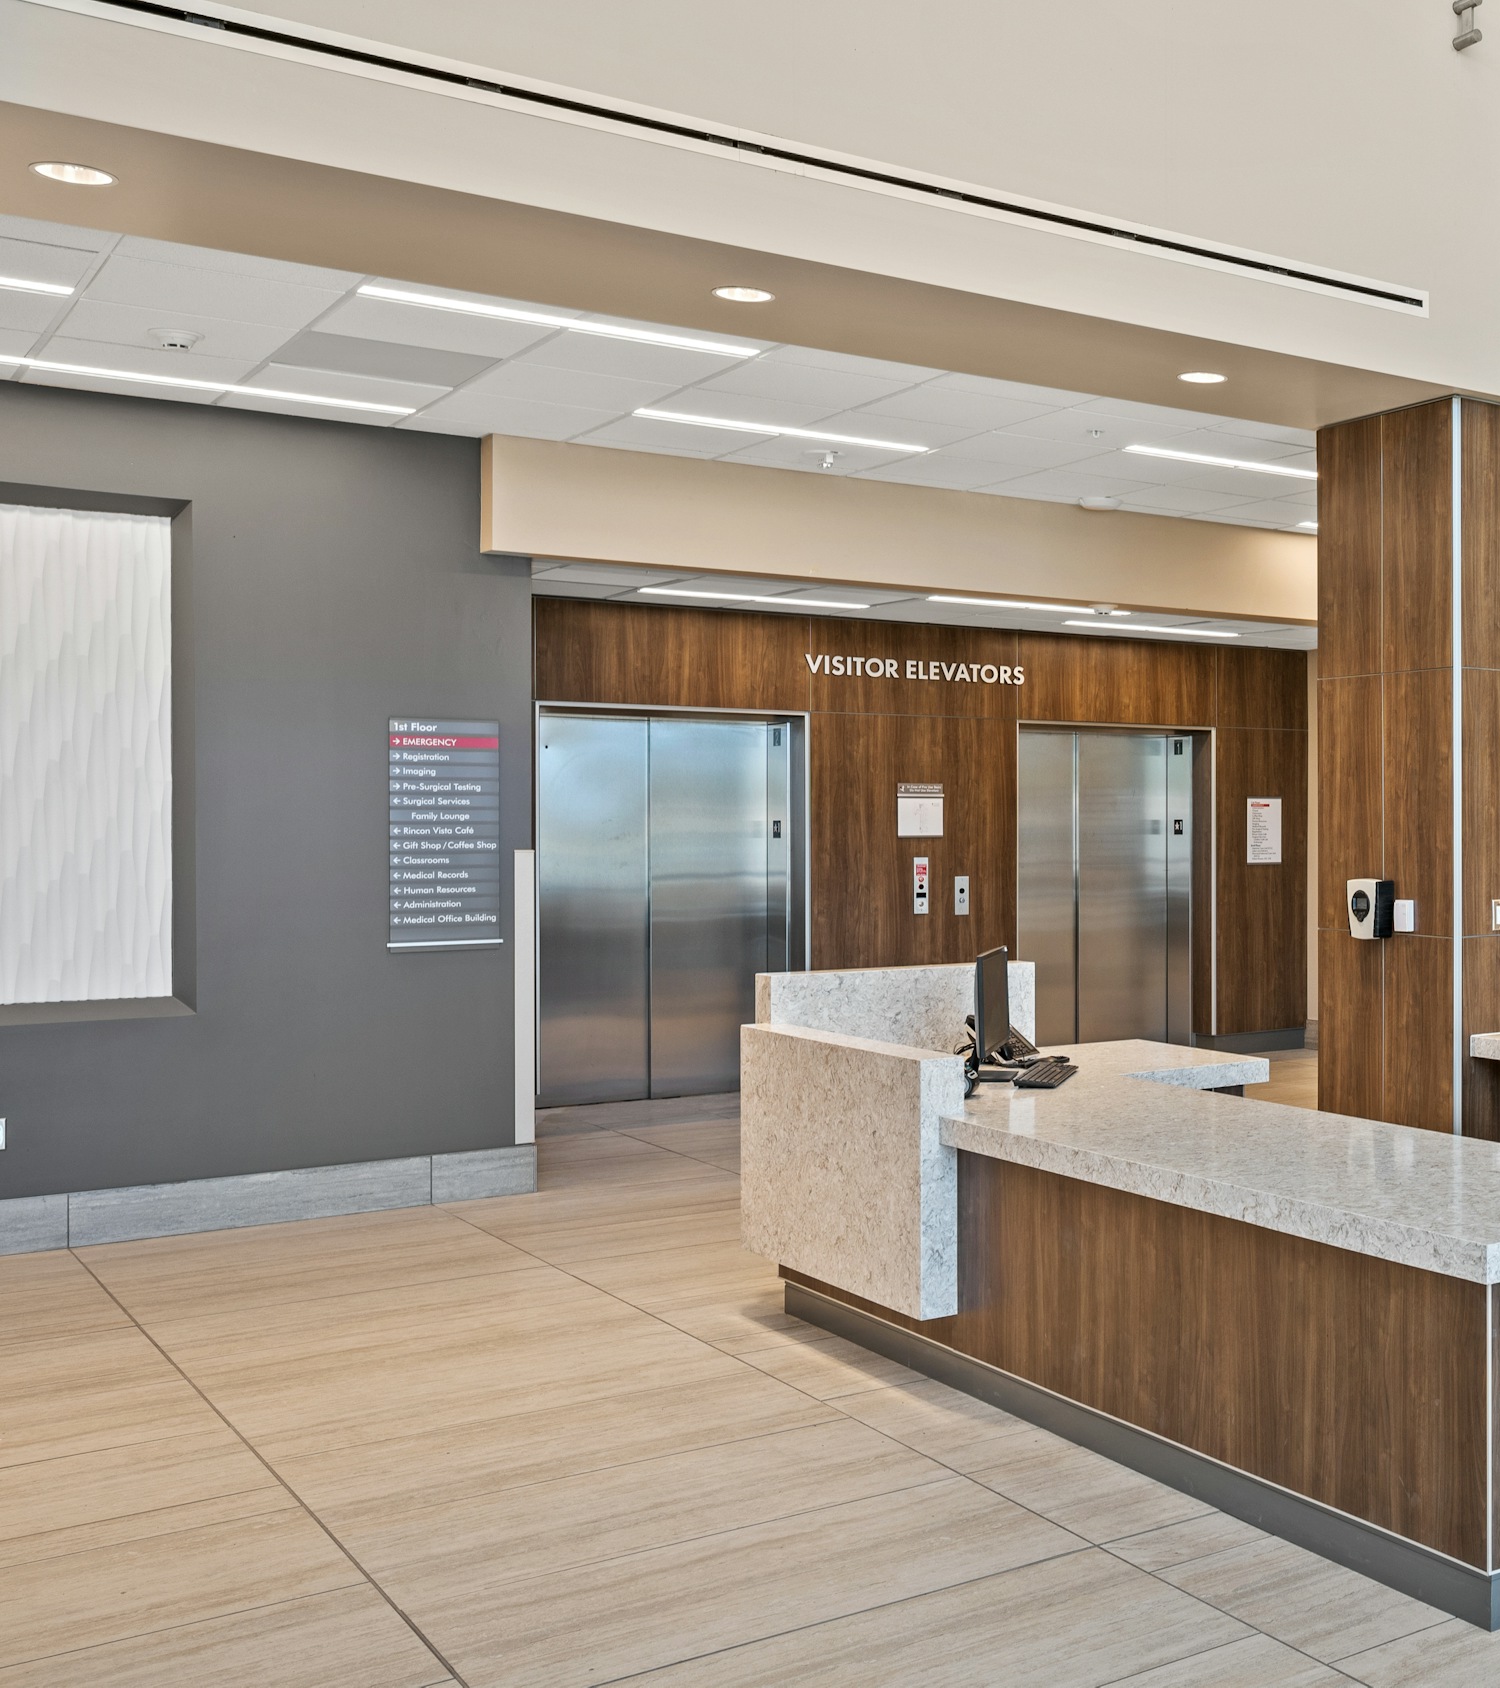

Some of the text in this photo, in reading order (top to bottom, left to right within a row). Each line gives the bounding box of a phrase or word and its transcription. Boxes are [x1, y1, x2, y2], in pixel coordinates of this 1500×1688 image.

[805, 654, 1025, 685] VISITOR ELEVATORS
[394, 723, 437, 732] 1st Floor
[403, 738, 456, 746] EMERGENCY
[403, 753, 449, 762] Registration
[403, 768, 436, 776] Imaging
[403, 783, 481, 792] Pre-Surgical Testing
[403, 798, 435, 806] Surgical
[412, 813, 470, 821] Family Lounge
[421, 842, 441, 850] Shop
[477, 841, 496, 850] Shop
[438, 915, 462, 923] Office
[465, 914, 496, 922] Building
